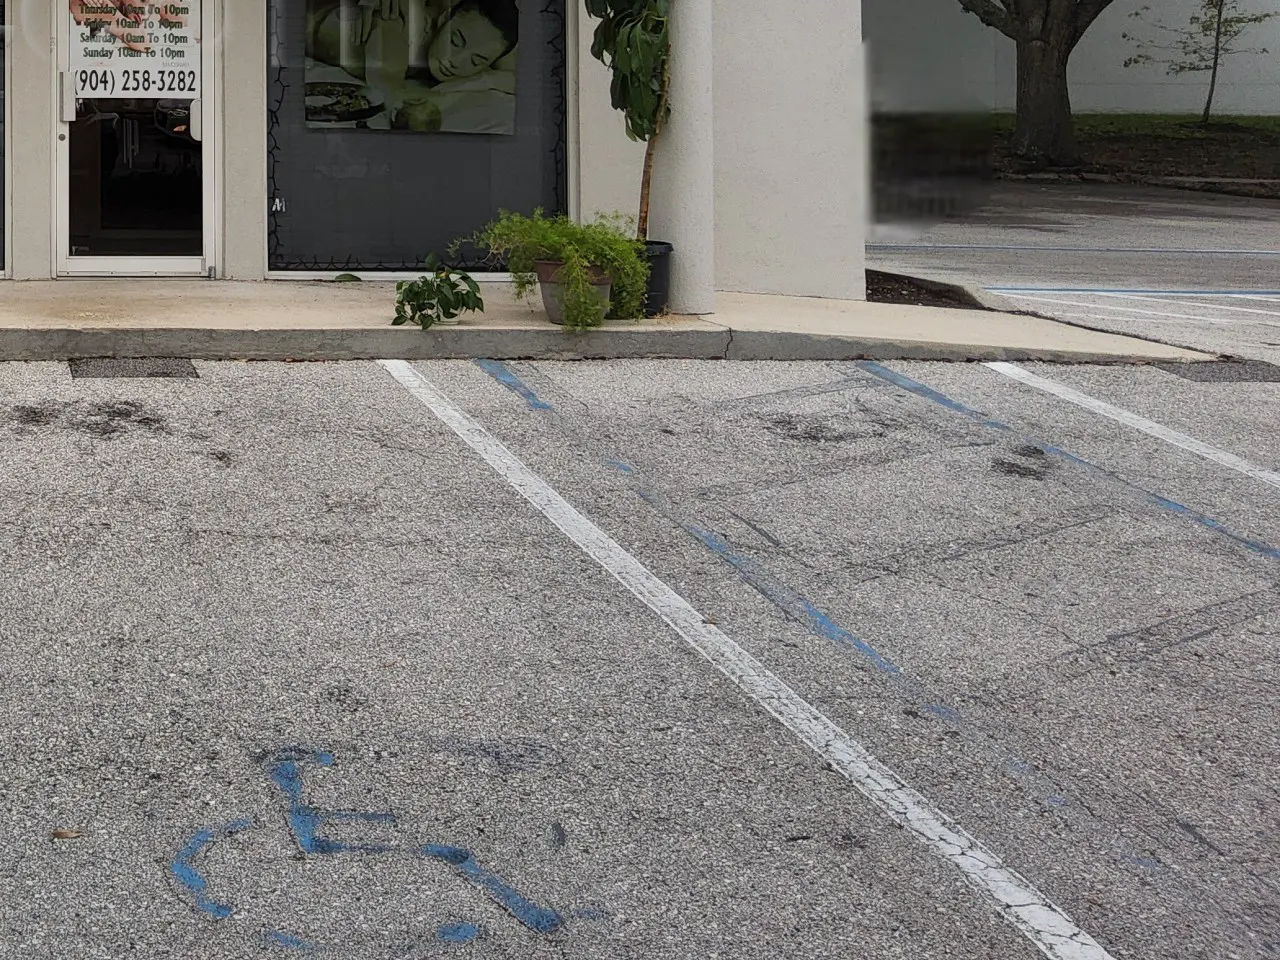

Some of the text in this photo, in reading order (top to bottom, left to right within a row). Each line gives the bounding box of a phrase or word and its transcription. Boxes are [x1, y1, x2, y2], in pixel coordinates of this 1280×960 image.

[80, 4, 117, 16] Thursday
[148, 4, 160, 14] To
[164, 4, 189, 16] 10pm
[116, 18, 140, 28] 10am
[143, 19, 154, 29] To
[158, 19, 183, 30] 10pm
[80, 32, 188, 45] Saturday 10am To 10pm
[83, 47, 185, 59] Sunday 10am To 10pm
[75, 70, 196, 95] (904) 258-3282
